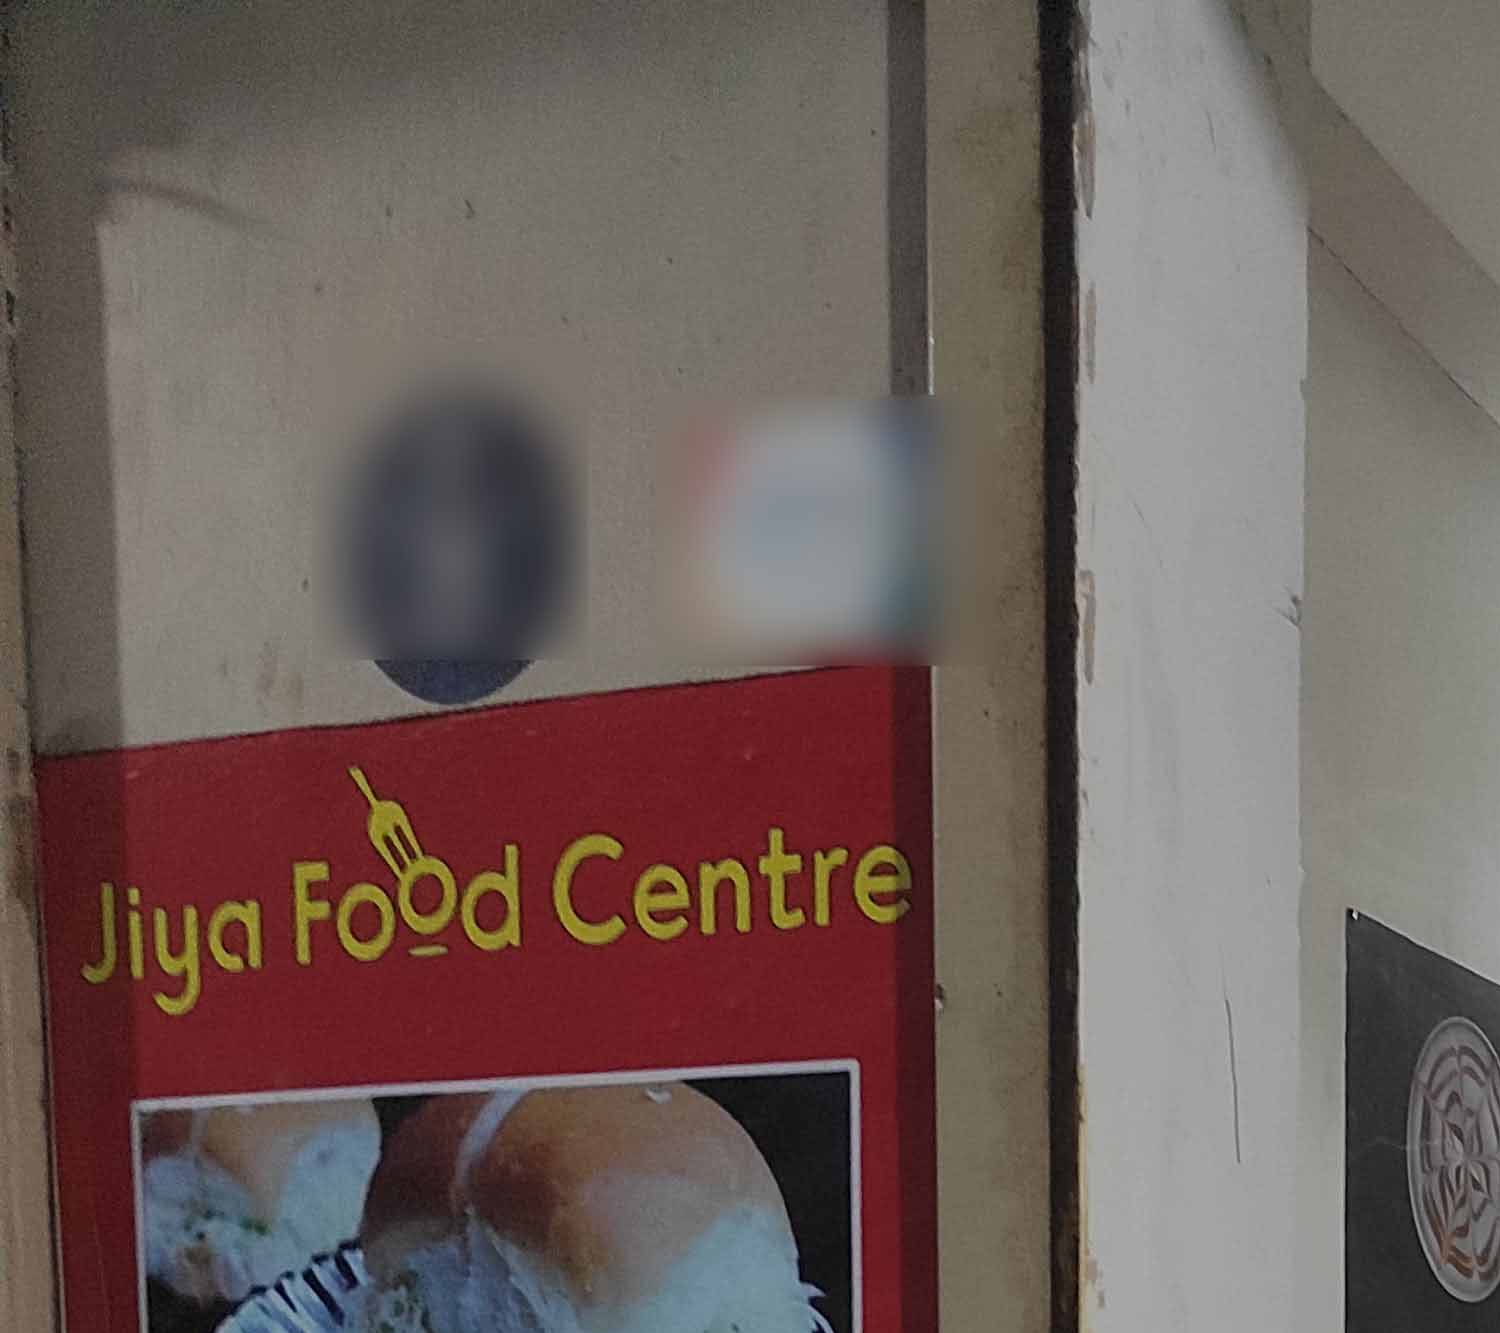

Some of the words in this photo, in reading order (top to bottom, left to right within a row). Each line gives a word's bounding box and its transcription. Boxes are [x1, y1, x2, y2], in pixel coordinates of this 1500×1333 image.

[82, 880, 262, 1016] Jiya
[293, 842, 521, 965] Food
[552, 827, 913, 946] Centre
